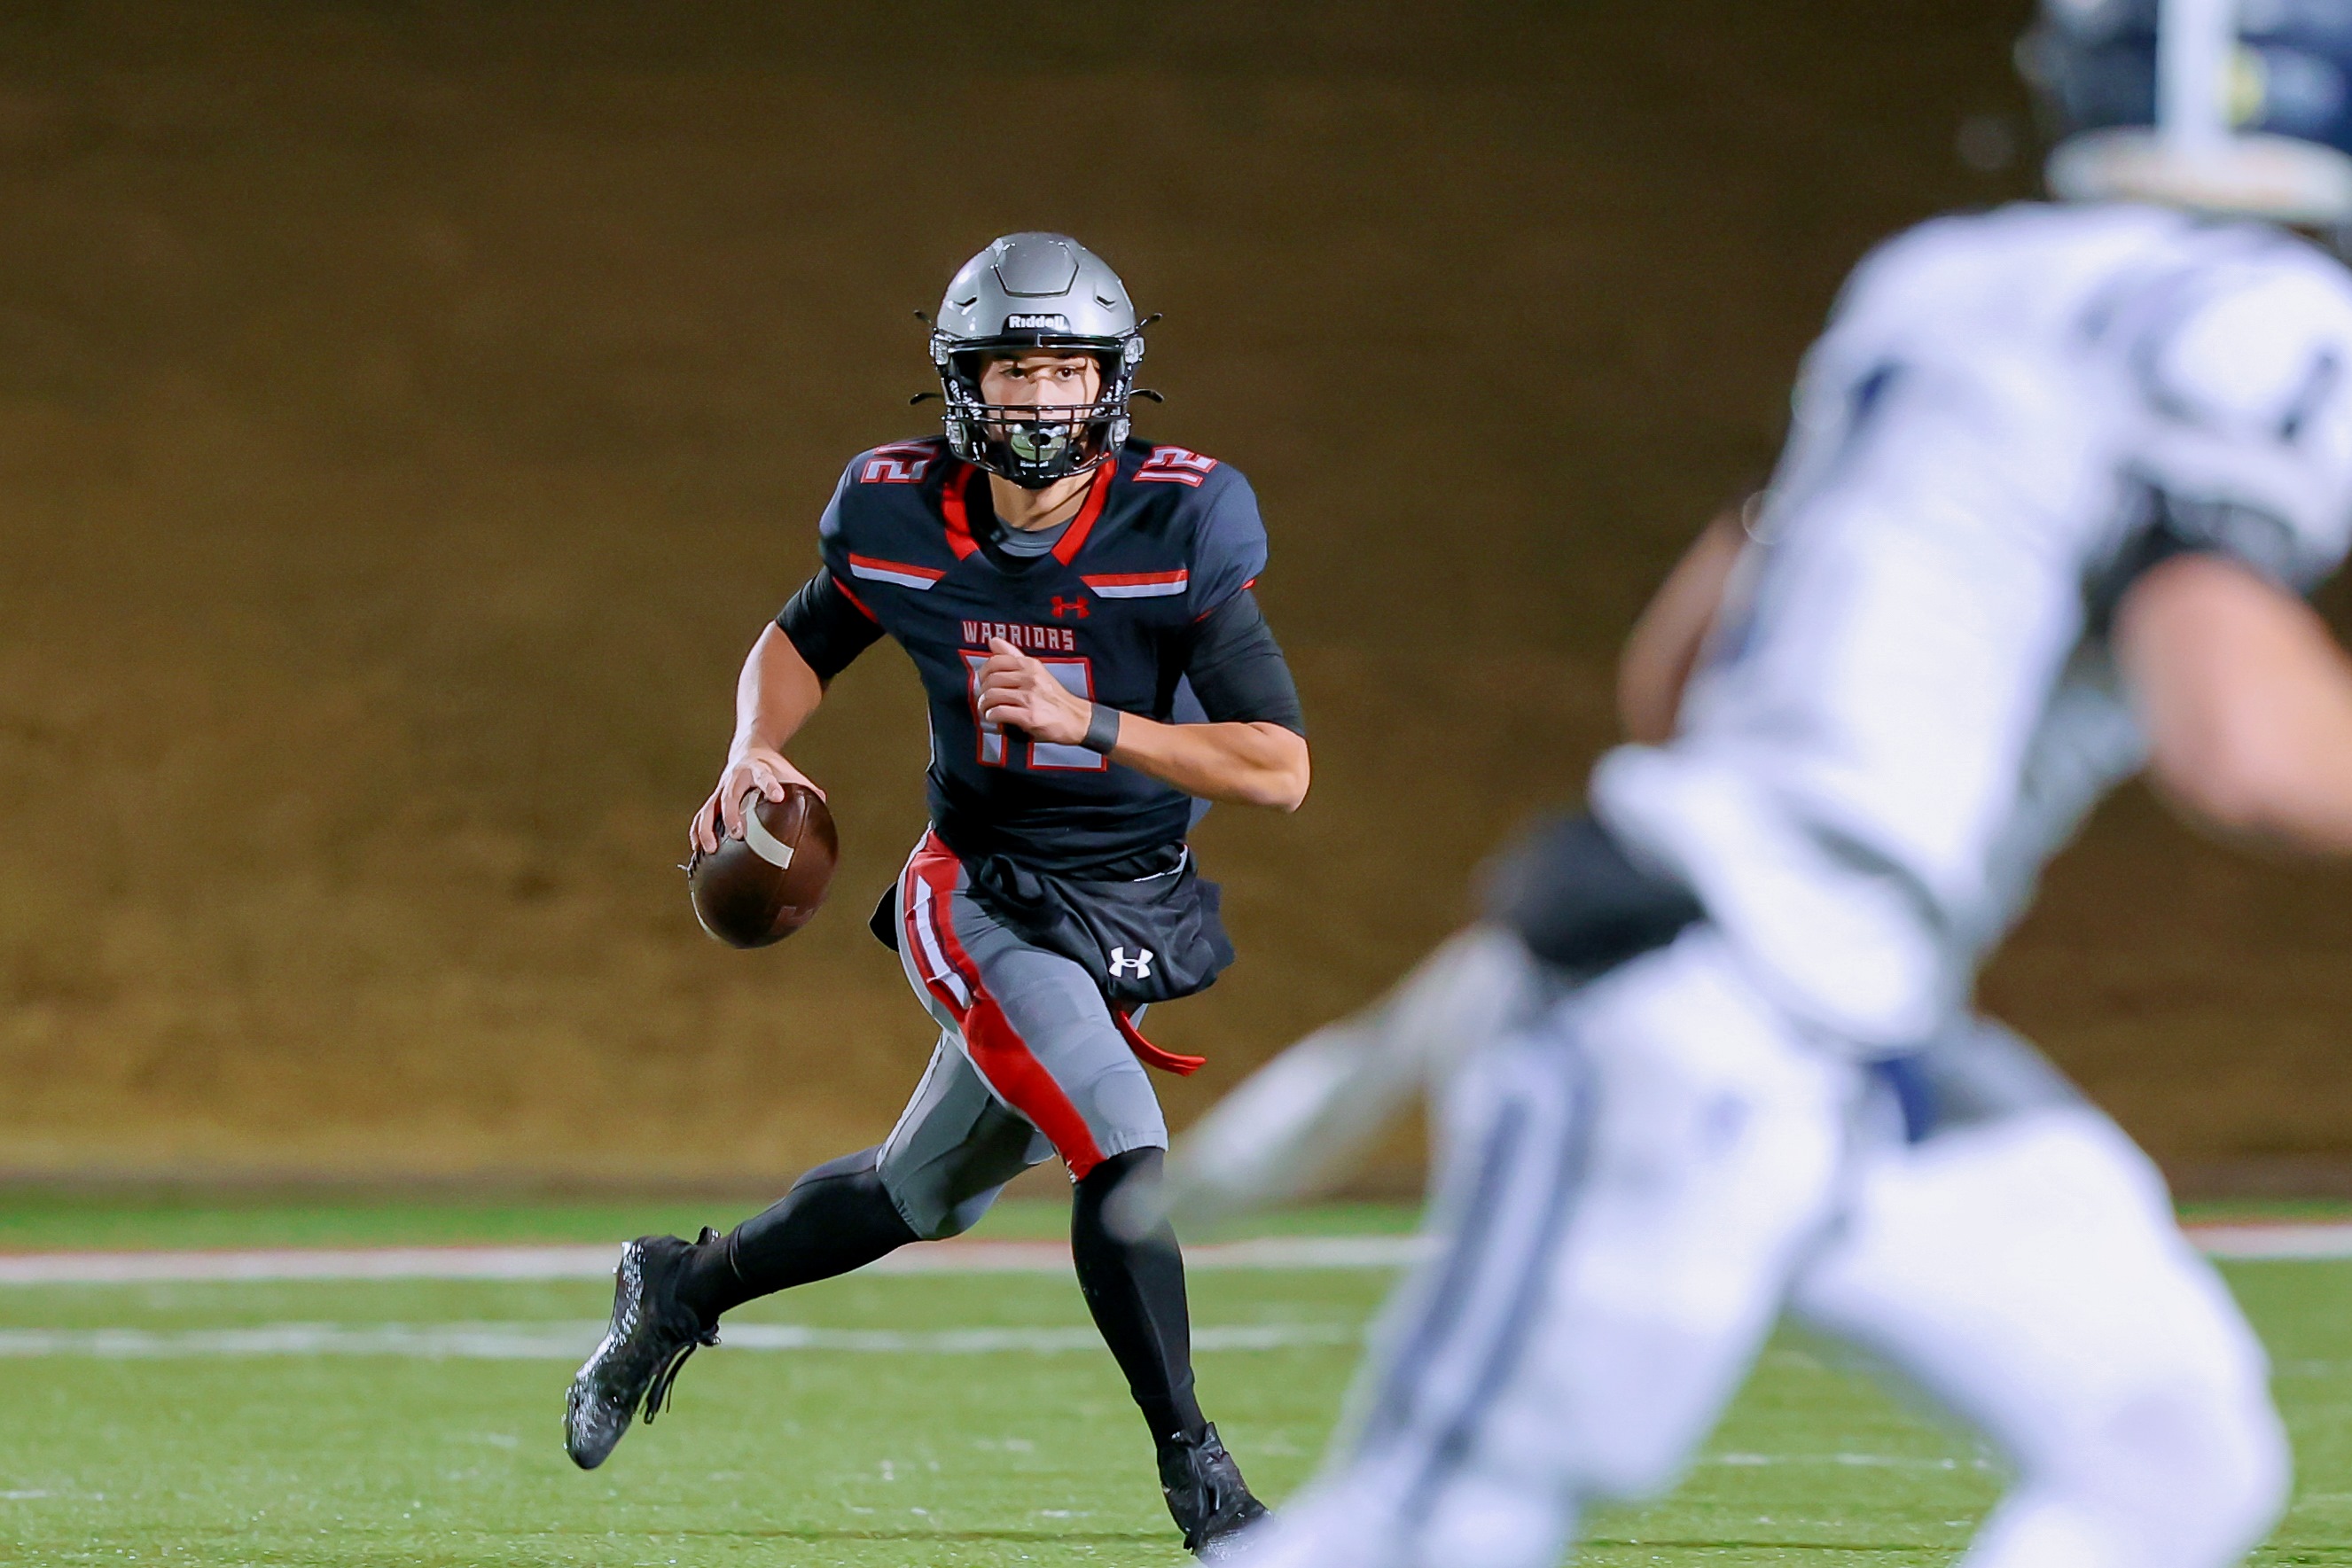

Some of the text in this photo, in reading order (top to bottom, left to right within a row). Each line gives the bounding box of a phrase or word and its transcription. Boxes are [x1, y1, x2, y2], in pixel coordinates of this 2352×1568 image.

[1009, 316, 1065, 329] Riddell
[1132, 445, 1219, 488] 12
[962, 620, 1075, 651] WARRIORS
